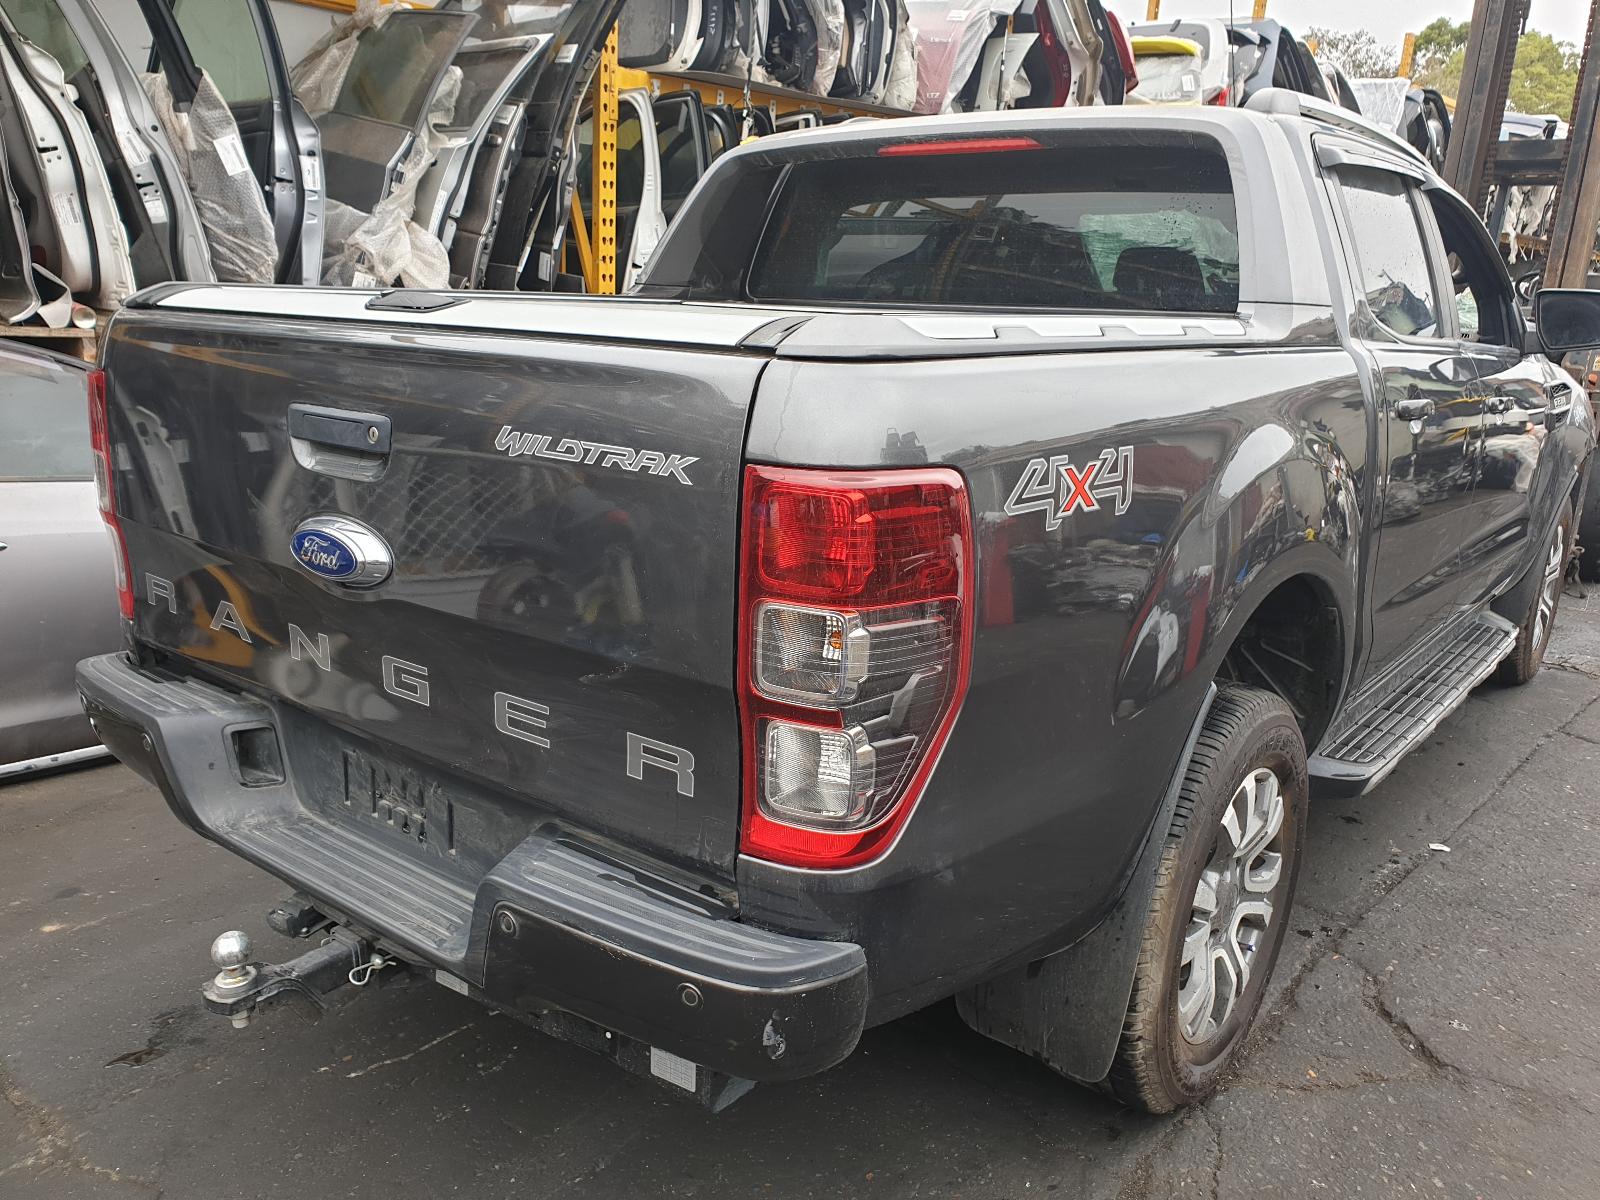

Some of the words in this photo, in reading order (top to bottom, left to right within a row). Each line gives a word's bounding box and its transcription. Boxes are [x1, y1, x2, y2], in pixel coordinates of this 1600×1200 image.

[494, 426, 699, 485] WILDTRAK
[301, 535, 341, 571] Ford
[145, 572, 695, 797] RANGER
